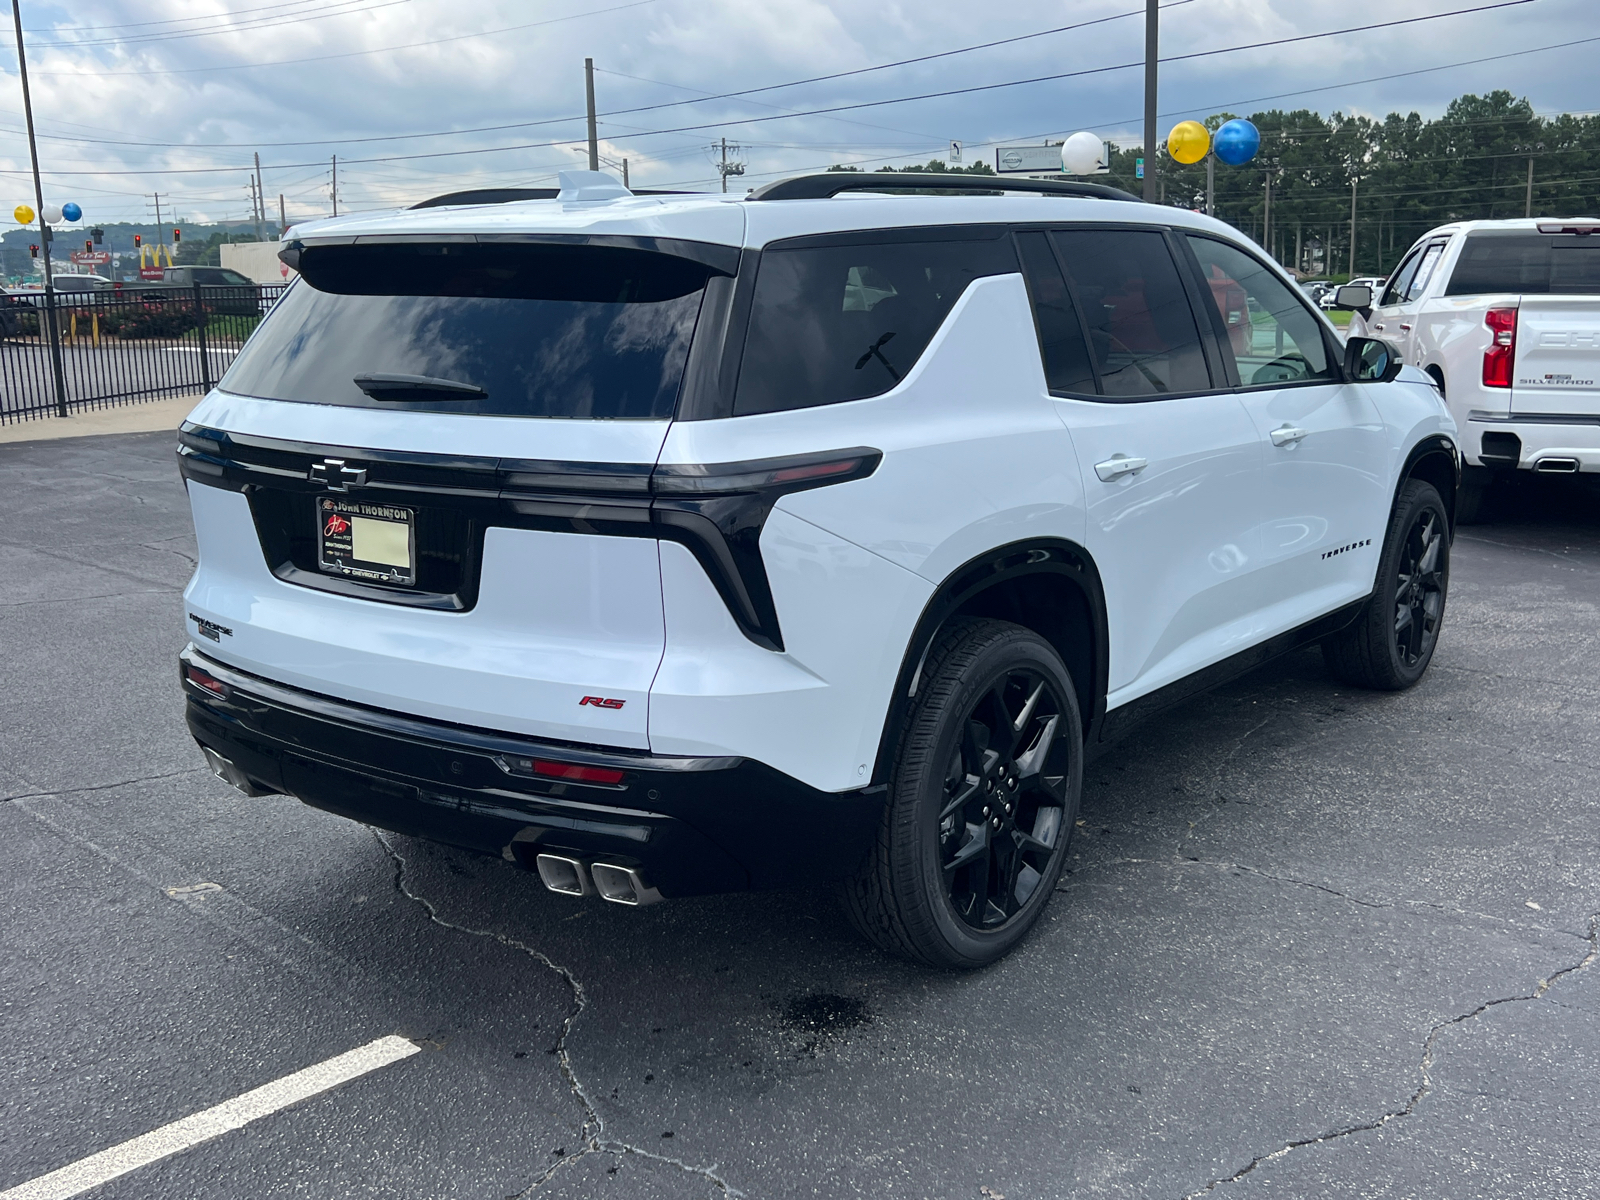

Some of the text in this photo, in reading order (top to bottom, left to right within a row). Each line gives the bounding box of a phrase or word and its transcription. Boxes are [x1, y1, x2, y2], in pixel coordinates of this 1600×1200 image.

[338, 502, 407, 519] JOHN THORNTON
[1321, 539, 1372, 560] TRAVERSE
[352, 568, 380, 579] CHEVROLET
[578, 695, 626, 709] RS
